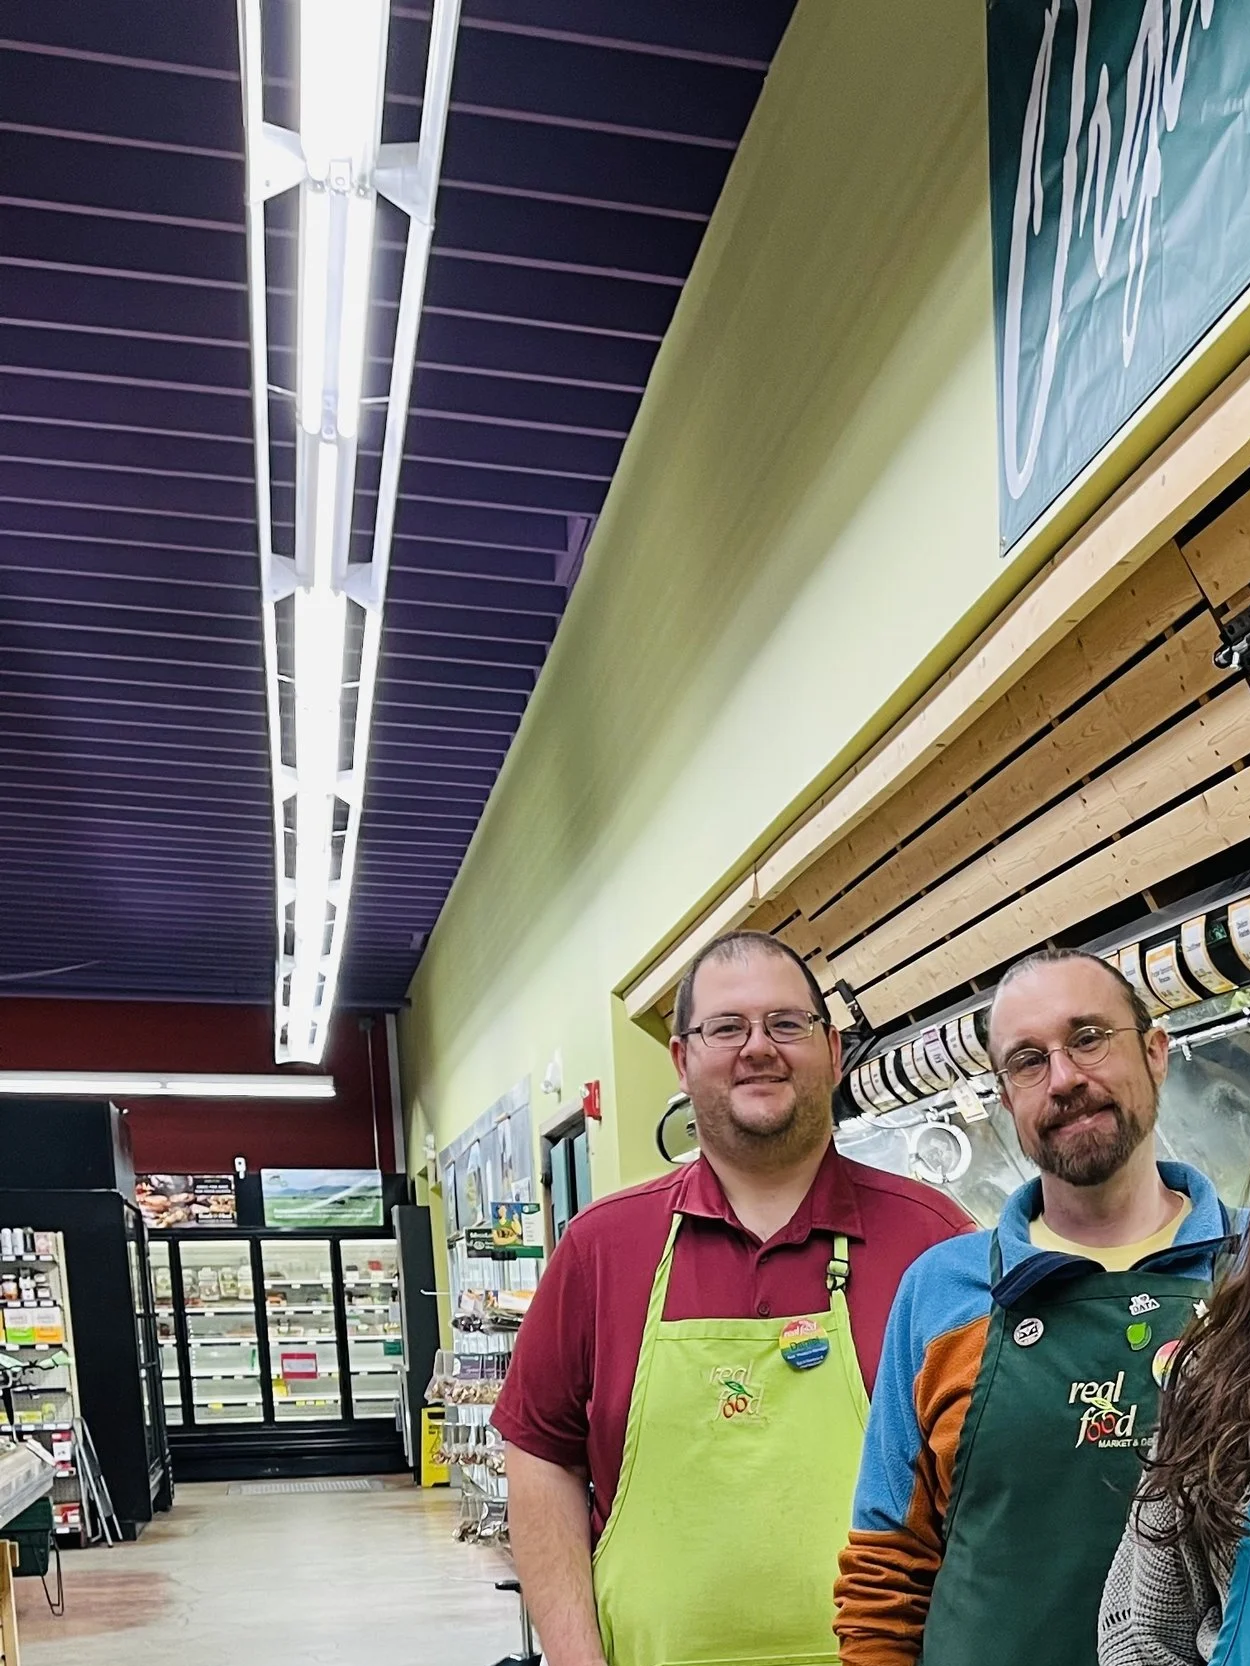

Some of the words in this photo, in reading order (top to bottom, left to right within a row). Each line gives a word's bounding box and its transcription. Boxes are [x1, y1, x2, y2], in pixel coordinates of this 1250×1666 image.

[1133, 1301, 1157, 1313] DATA
[710, 1362, 754, 1385] real
[1069, 1371, 1125, 1404] real
[714, 1386, 765, 1421] food
[1075, 1405, 1138, 1448] food
[1099, 1438, 1132, 1448] MARKET
[1133, 1438, 1139, 1446] &
